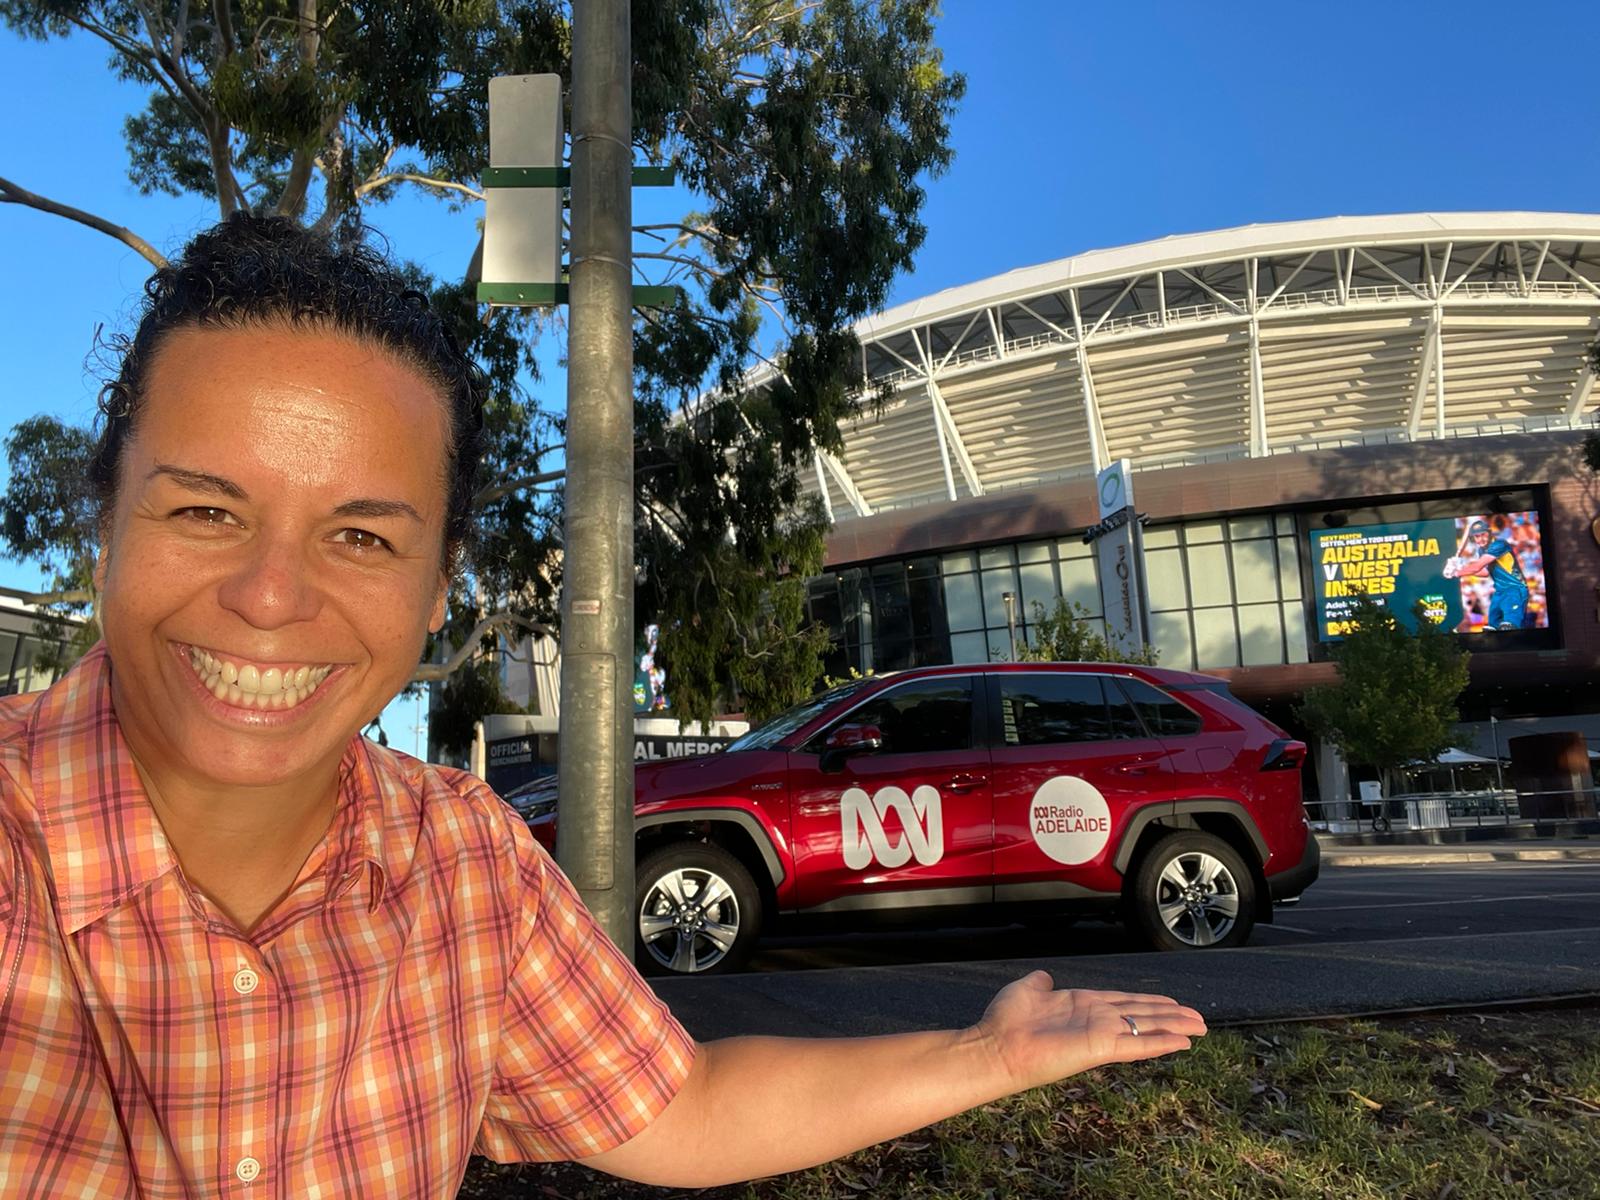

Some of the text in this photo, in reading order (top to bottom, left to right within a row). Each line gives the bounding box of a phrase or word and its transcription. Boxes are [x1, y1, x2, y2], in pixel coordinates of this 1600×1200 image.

[1322, 539, 1440, 564] AUSTRALIA
[1323, 558, 1403, 581] V WEST
[490, 740, 532, 758] OFFICIAL
[666, 742, 726, 758] MERC
[1050, 805, 1084, 818] Radio
[1036, 818, 1107, 834] ADELAIDE
